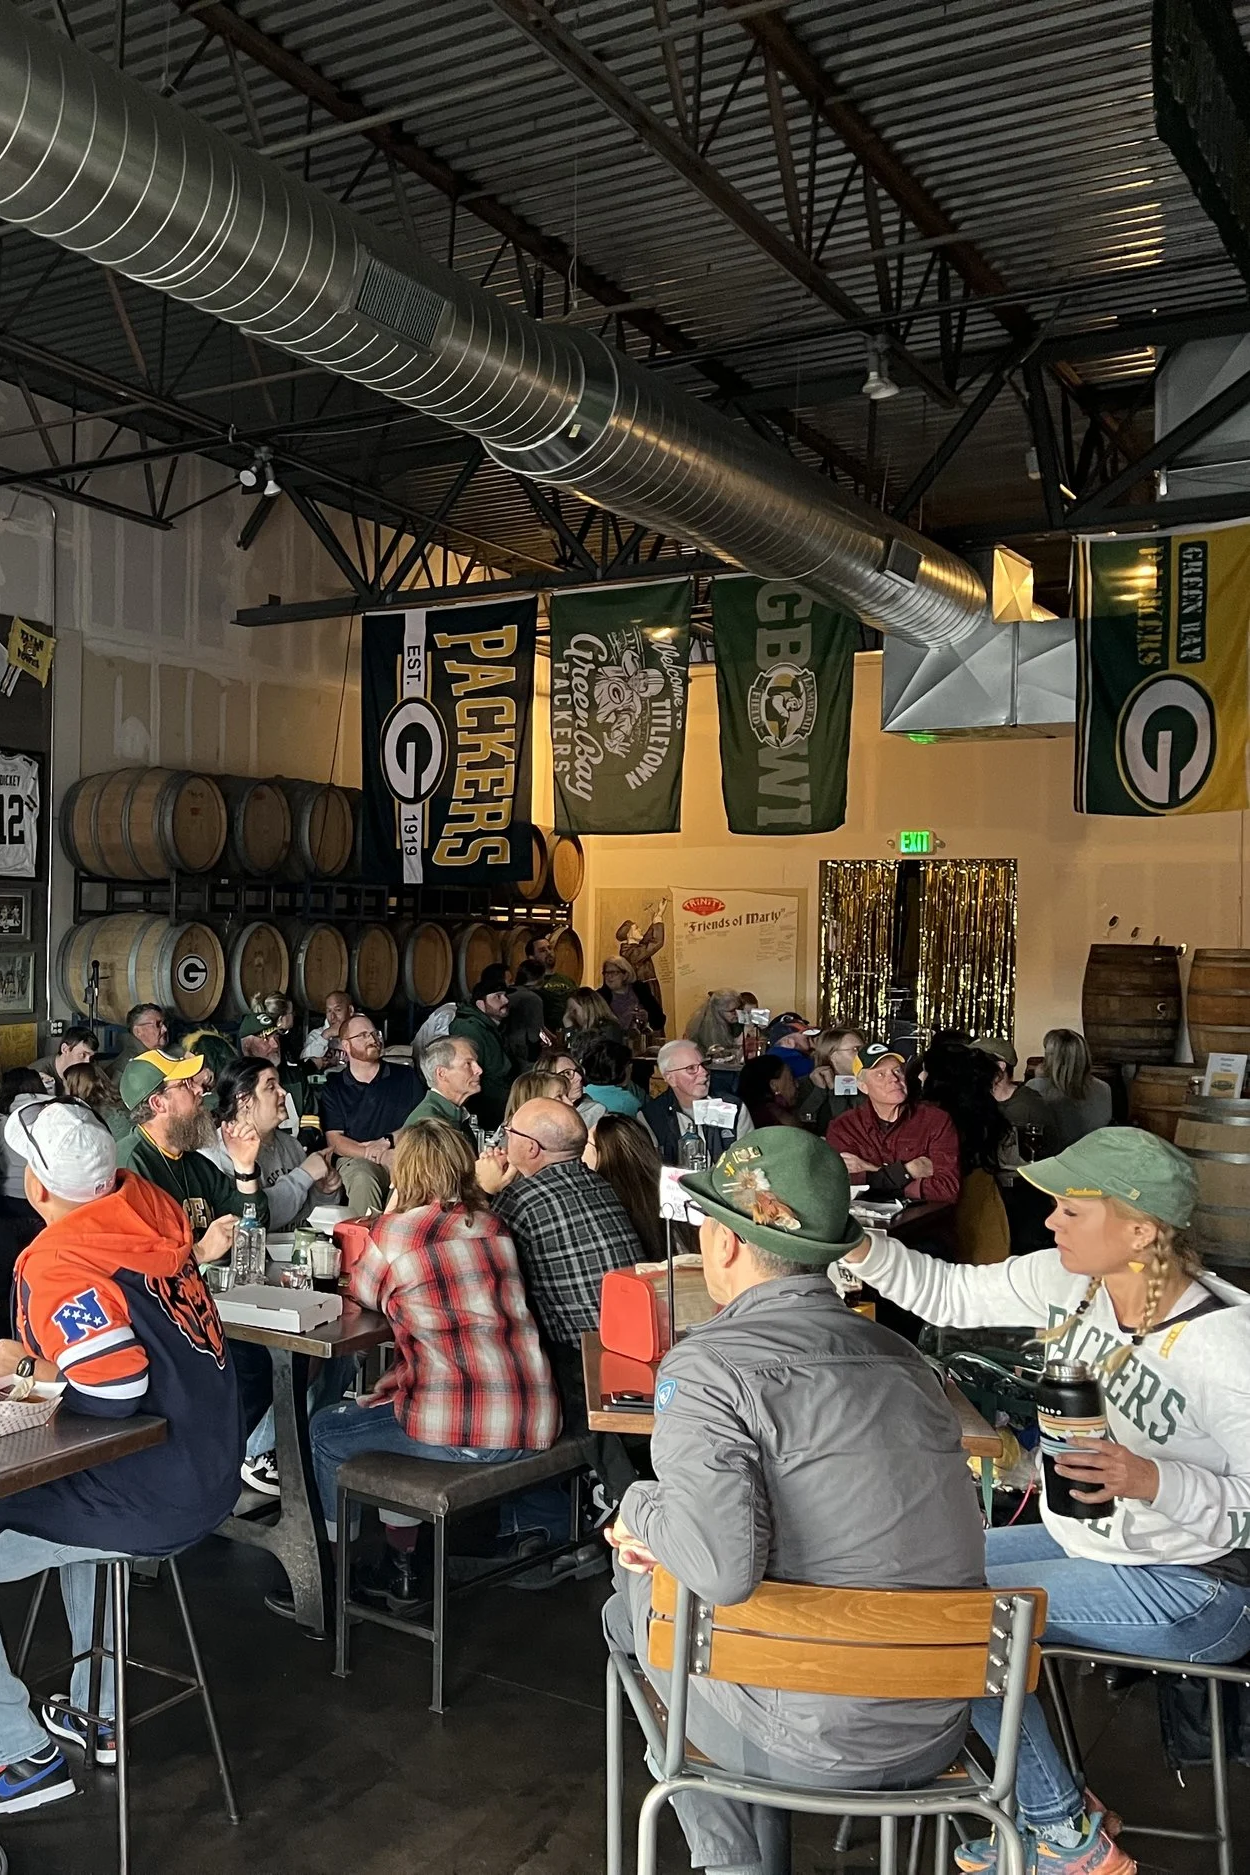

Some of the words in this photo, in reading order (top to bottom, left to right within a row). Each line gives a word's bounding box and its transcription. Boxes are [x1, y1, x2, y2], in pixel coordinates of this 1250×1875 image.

[1181, 547, 1204, 614] GREEN
[756, 581, 814, 672] GB
[1180, 621, 1202, 659] BAY
[406, 645, 421, 685] EST.
[563, 633, 608, 728] Green
[648, 637, 687, 707] Welcome
[675, 713, 683, 730] TO
[554, 662, 573, 772] PACKERS
[751, 690, 761, 725] FIELD
[803, 675, 816, 732] LAMBEAU
[432, 625, 518, 866] PACKERS
[565, 730, 605, 801] Bay
[625, 699, 671, 790] TITLETOWN
[0, 775, 21, 787] DICKEY
[756, 735, 813, 827] WI
[403, 814, 418, 856] 1919
[900, 831, 930, 853] EXIT
[683, 897, 726, 910] TRINITY
[684, 918, 730, 934] "Friends
[732, 915, 742, 926] of
[746, 907, 786, 924] Marty"
